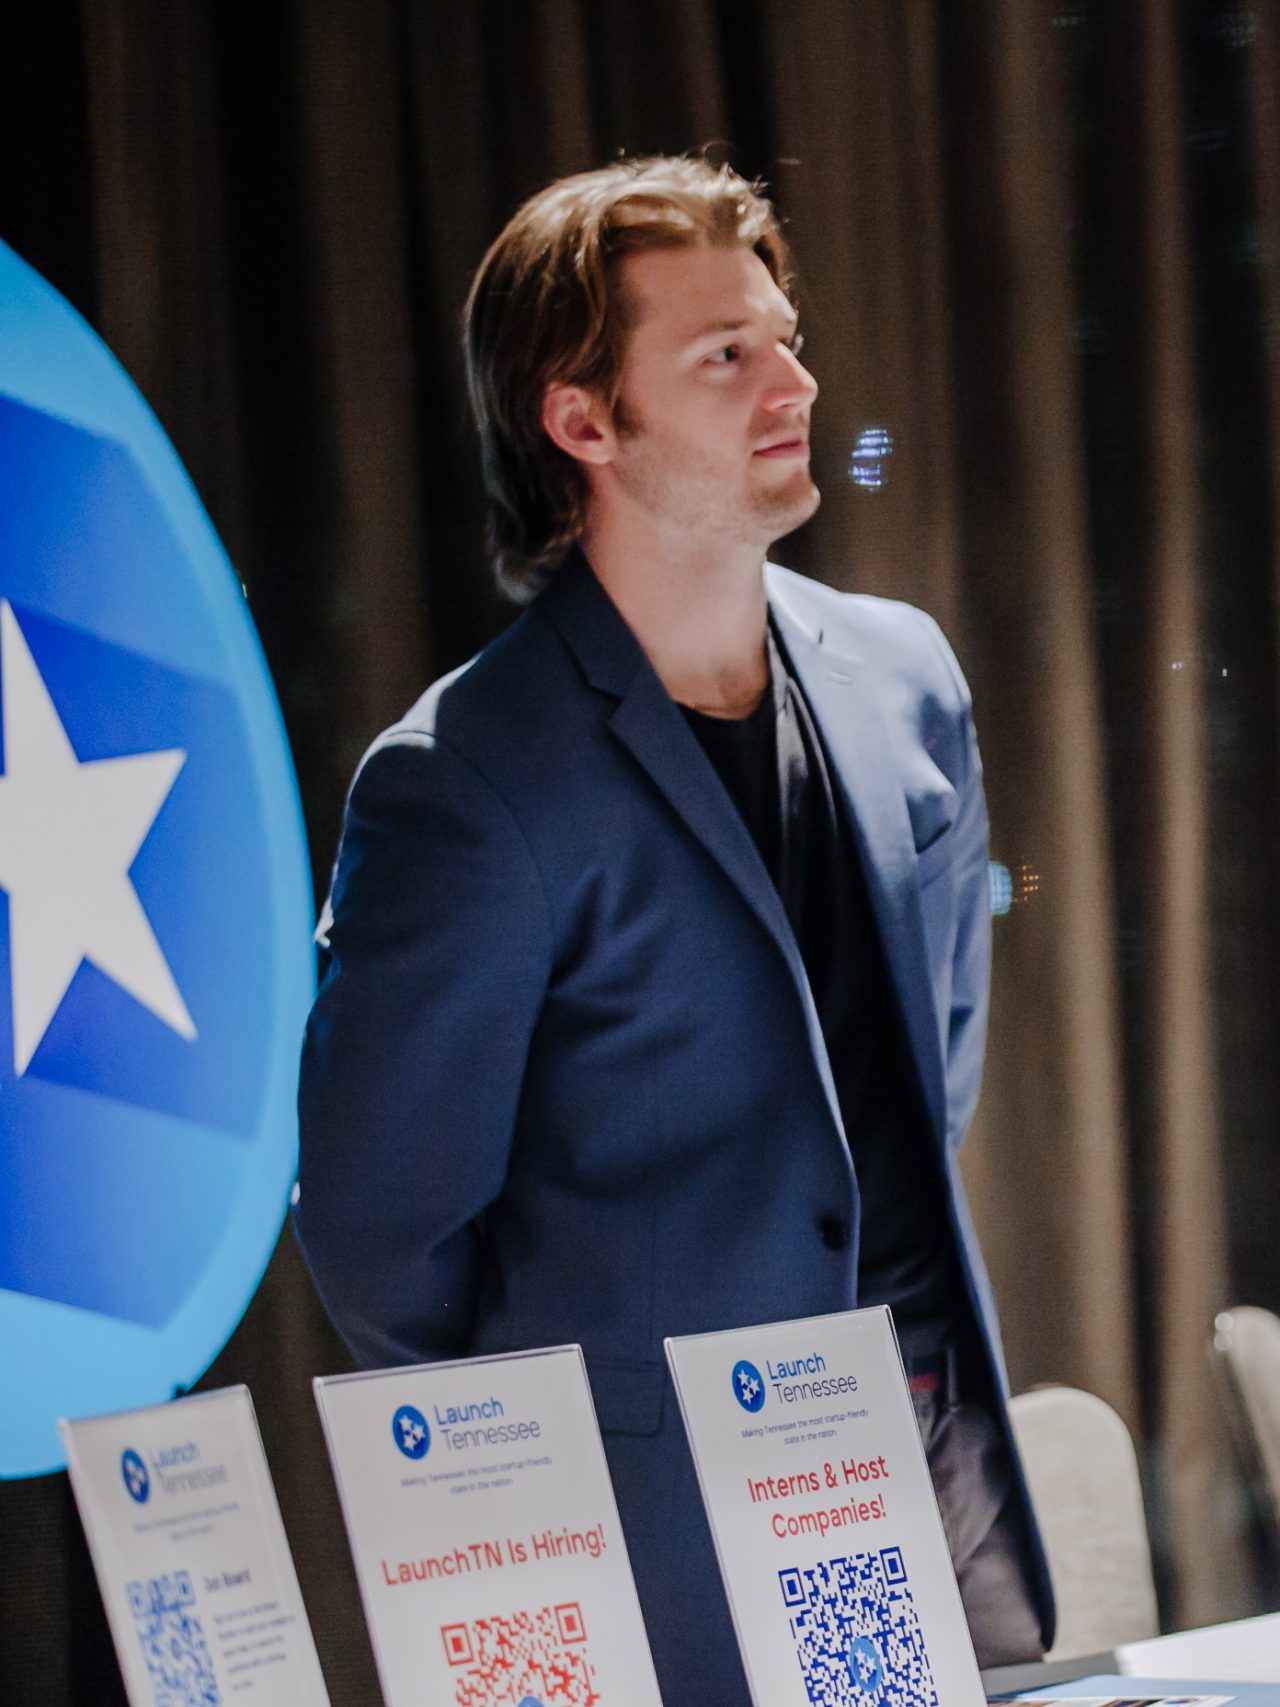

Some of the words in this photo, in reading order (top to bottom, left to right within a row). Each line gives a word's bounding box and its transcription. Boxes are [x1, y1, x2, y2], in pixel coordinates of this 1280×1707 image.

[767, 1352, 826, 1380] Launch
[773, 1373, 858, 1405] Tennessee
[433, 1397, 505, 1426] Launch
[765, 1422, 797, 1434] Tennessee
[797, 1419, 808, 1428] the
[809, 1417, 824, 1426] most
[442, 1419, 541, 1452] Tennessee
[784, 1435, 800, 1446] state
[801, 1433, 807, 1441] in
[807, 1432, 818, 1441] the
[748, 1469, 820, 1504] Interns
[824, 1462, 839, 1488] &
[842, 1455, 889, 1483] Host
[771, 1494, 886, 1540] Companies!
[382, 1537, 503, 1587] LaunchTN
[508, 1539, 528, 1565] Is
[532, 1523, 606, 1561] Hiring!
